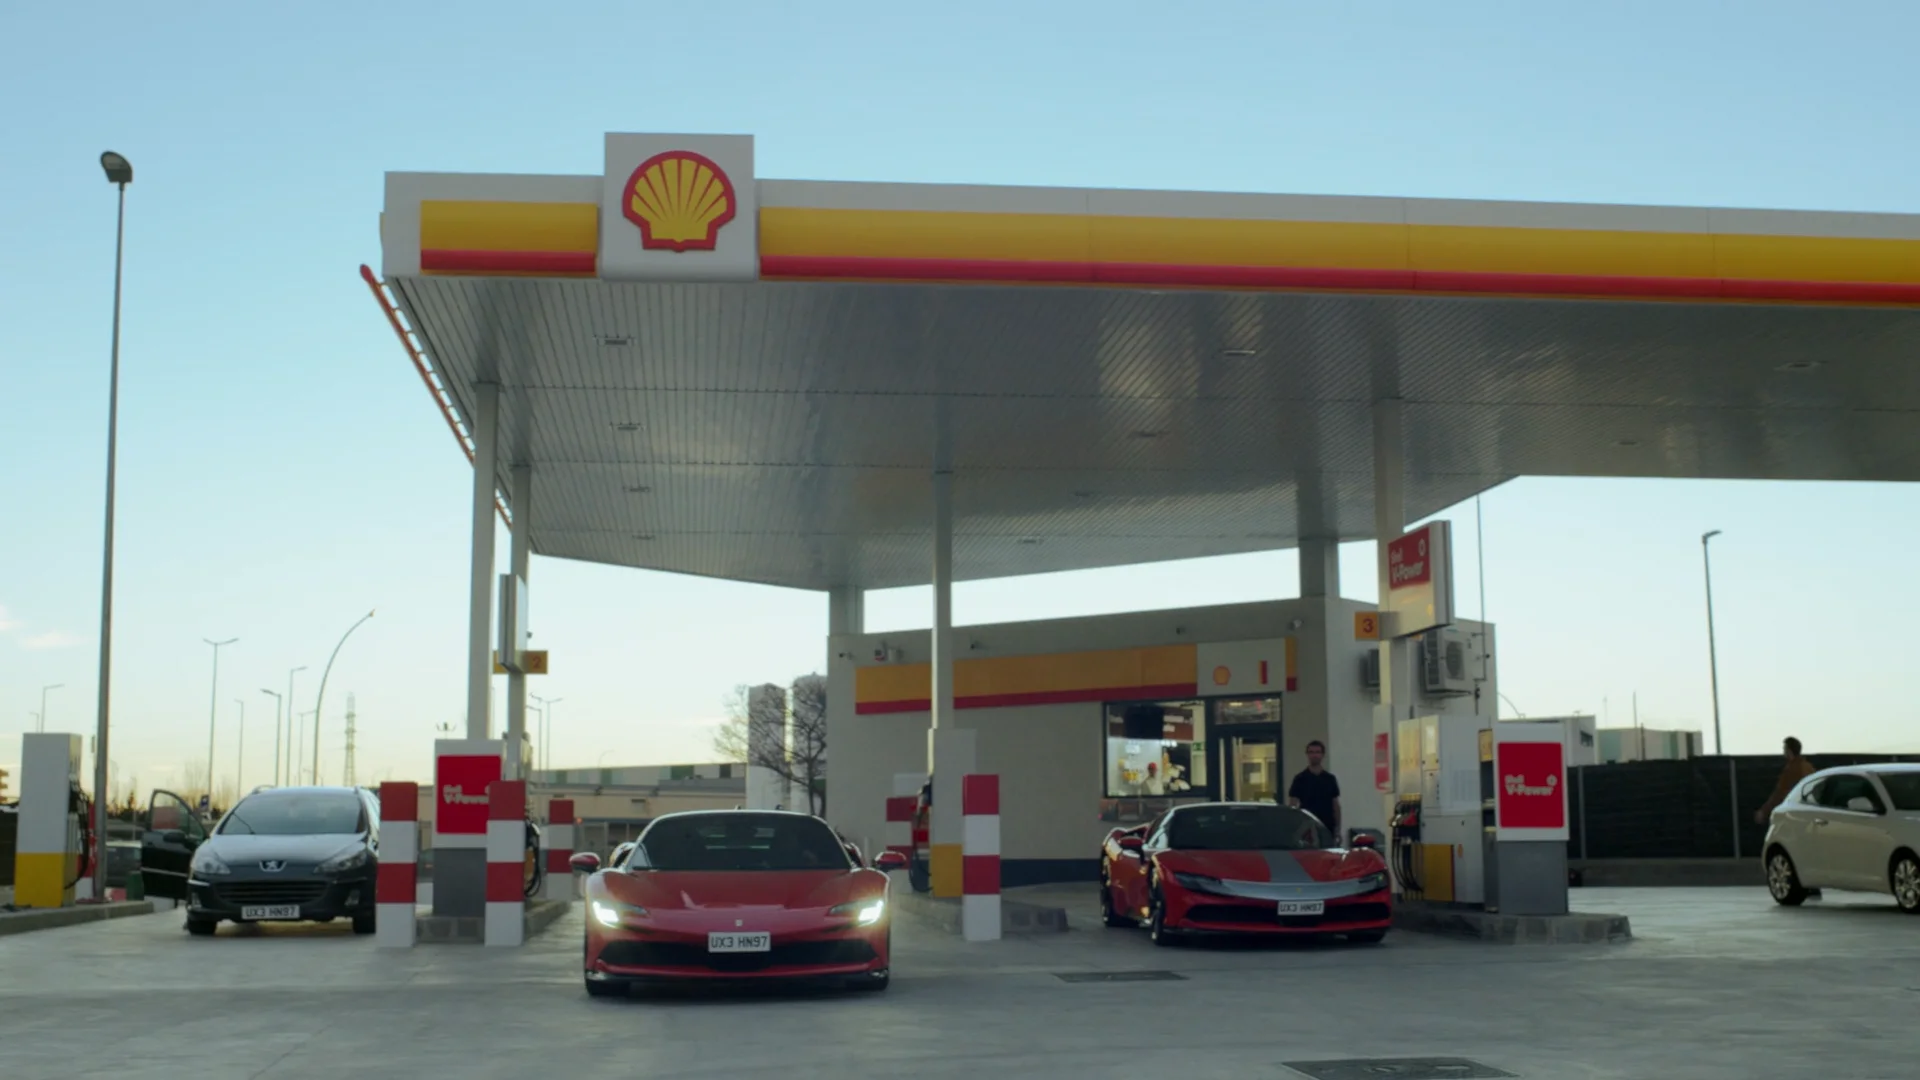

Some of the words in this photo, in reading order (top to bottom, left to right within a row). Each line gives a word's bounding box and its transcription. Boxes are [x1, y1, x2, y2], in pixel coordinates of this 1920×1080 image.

[1362, 618, 1374, 633] 3
[1505, 784, 1554, 796] V-Power
[443, 793, 489, 804] V-Powe
[711, 936, 734, 948] UX3
[737, 936, 768, 948] HN97
